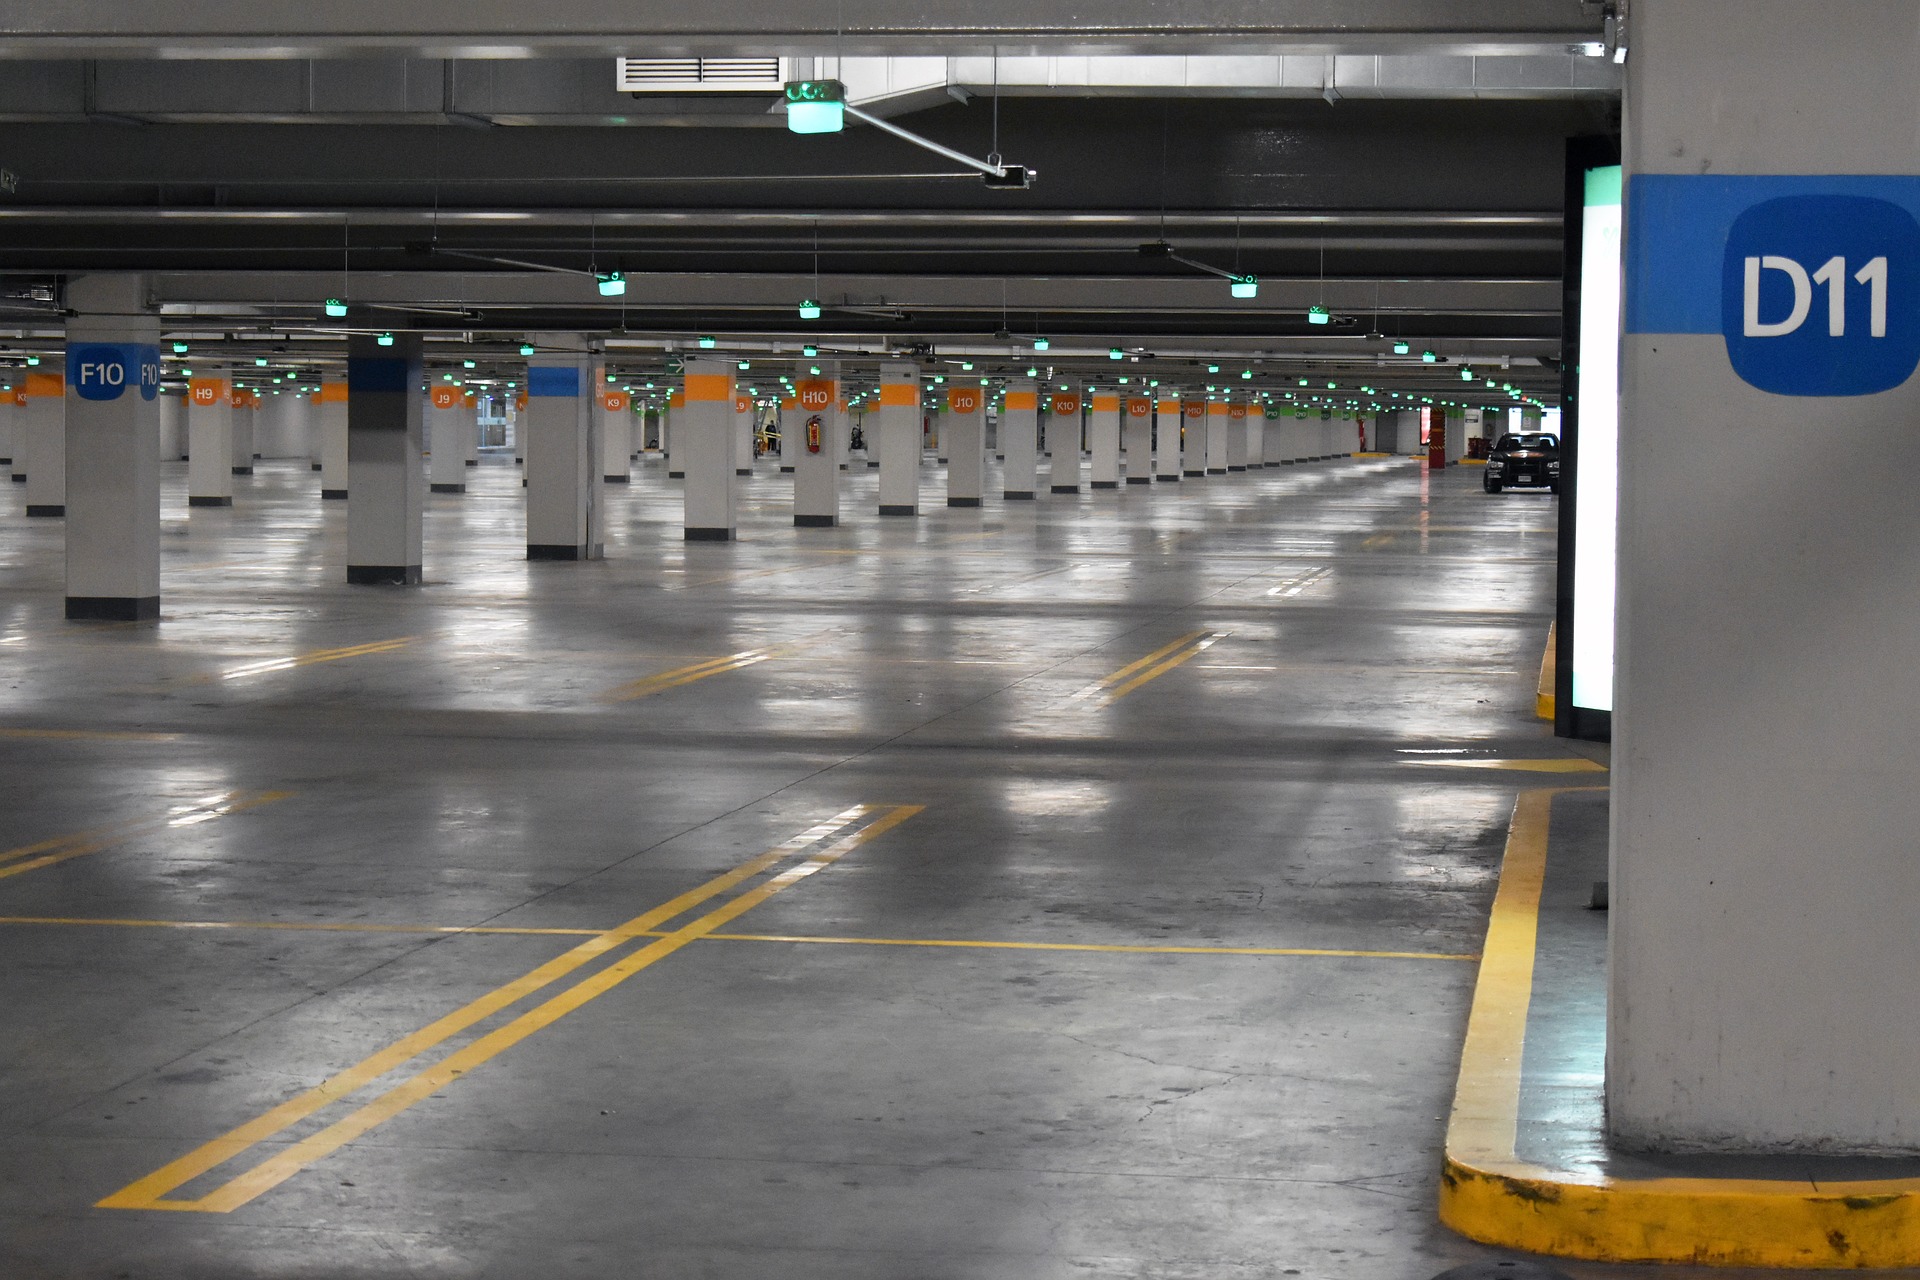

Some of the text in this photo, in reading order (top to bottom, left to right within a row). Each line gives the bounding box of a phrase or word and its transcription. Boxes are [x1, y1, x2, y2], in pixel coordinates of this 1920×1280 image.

[1743, 255, 1888, 338] D11
[80, 362, 124, 386] F10
[141, 363, 158, 386] F10
[196, 388, 213, 399] H9
[437, 394, 450, 404] J9
[802, 391, 828, 404] H10
[607, 398, 620, 407] K9
[954, 397, 974, 408] J10
[1056, 402, 1074, 411] K10
[1132, 405, 1146, 413] L10
[1186, 407, 1202, 415] M10
